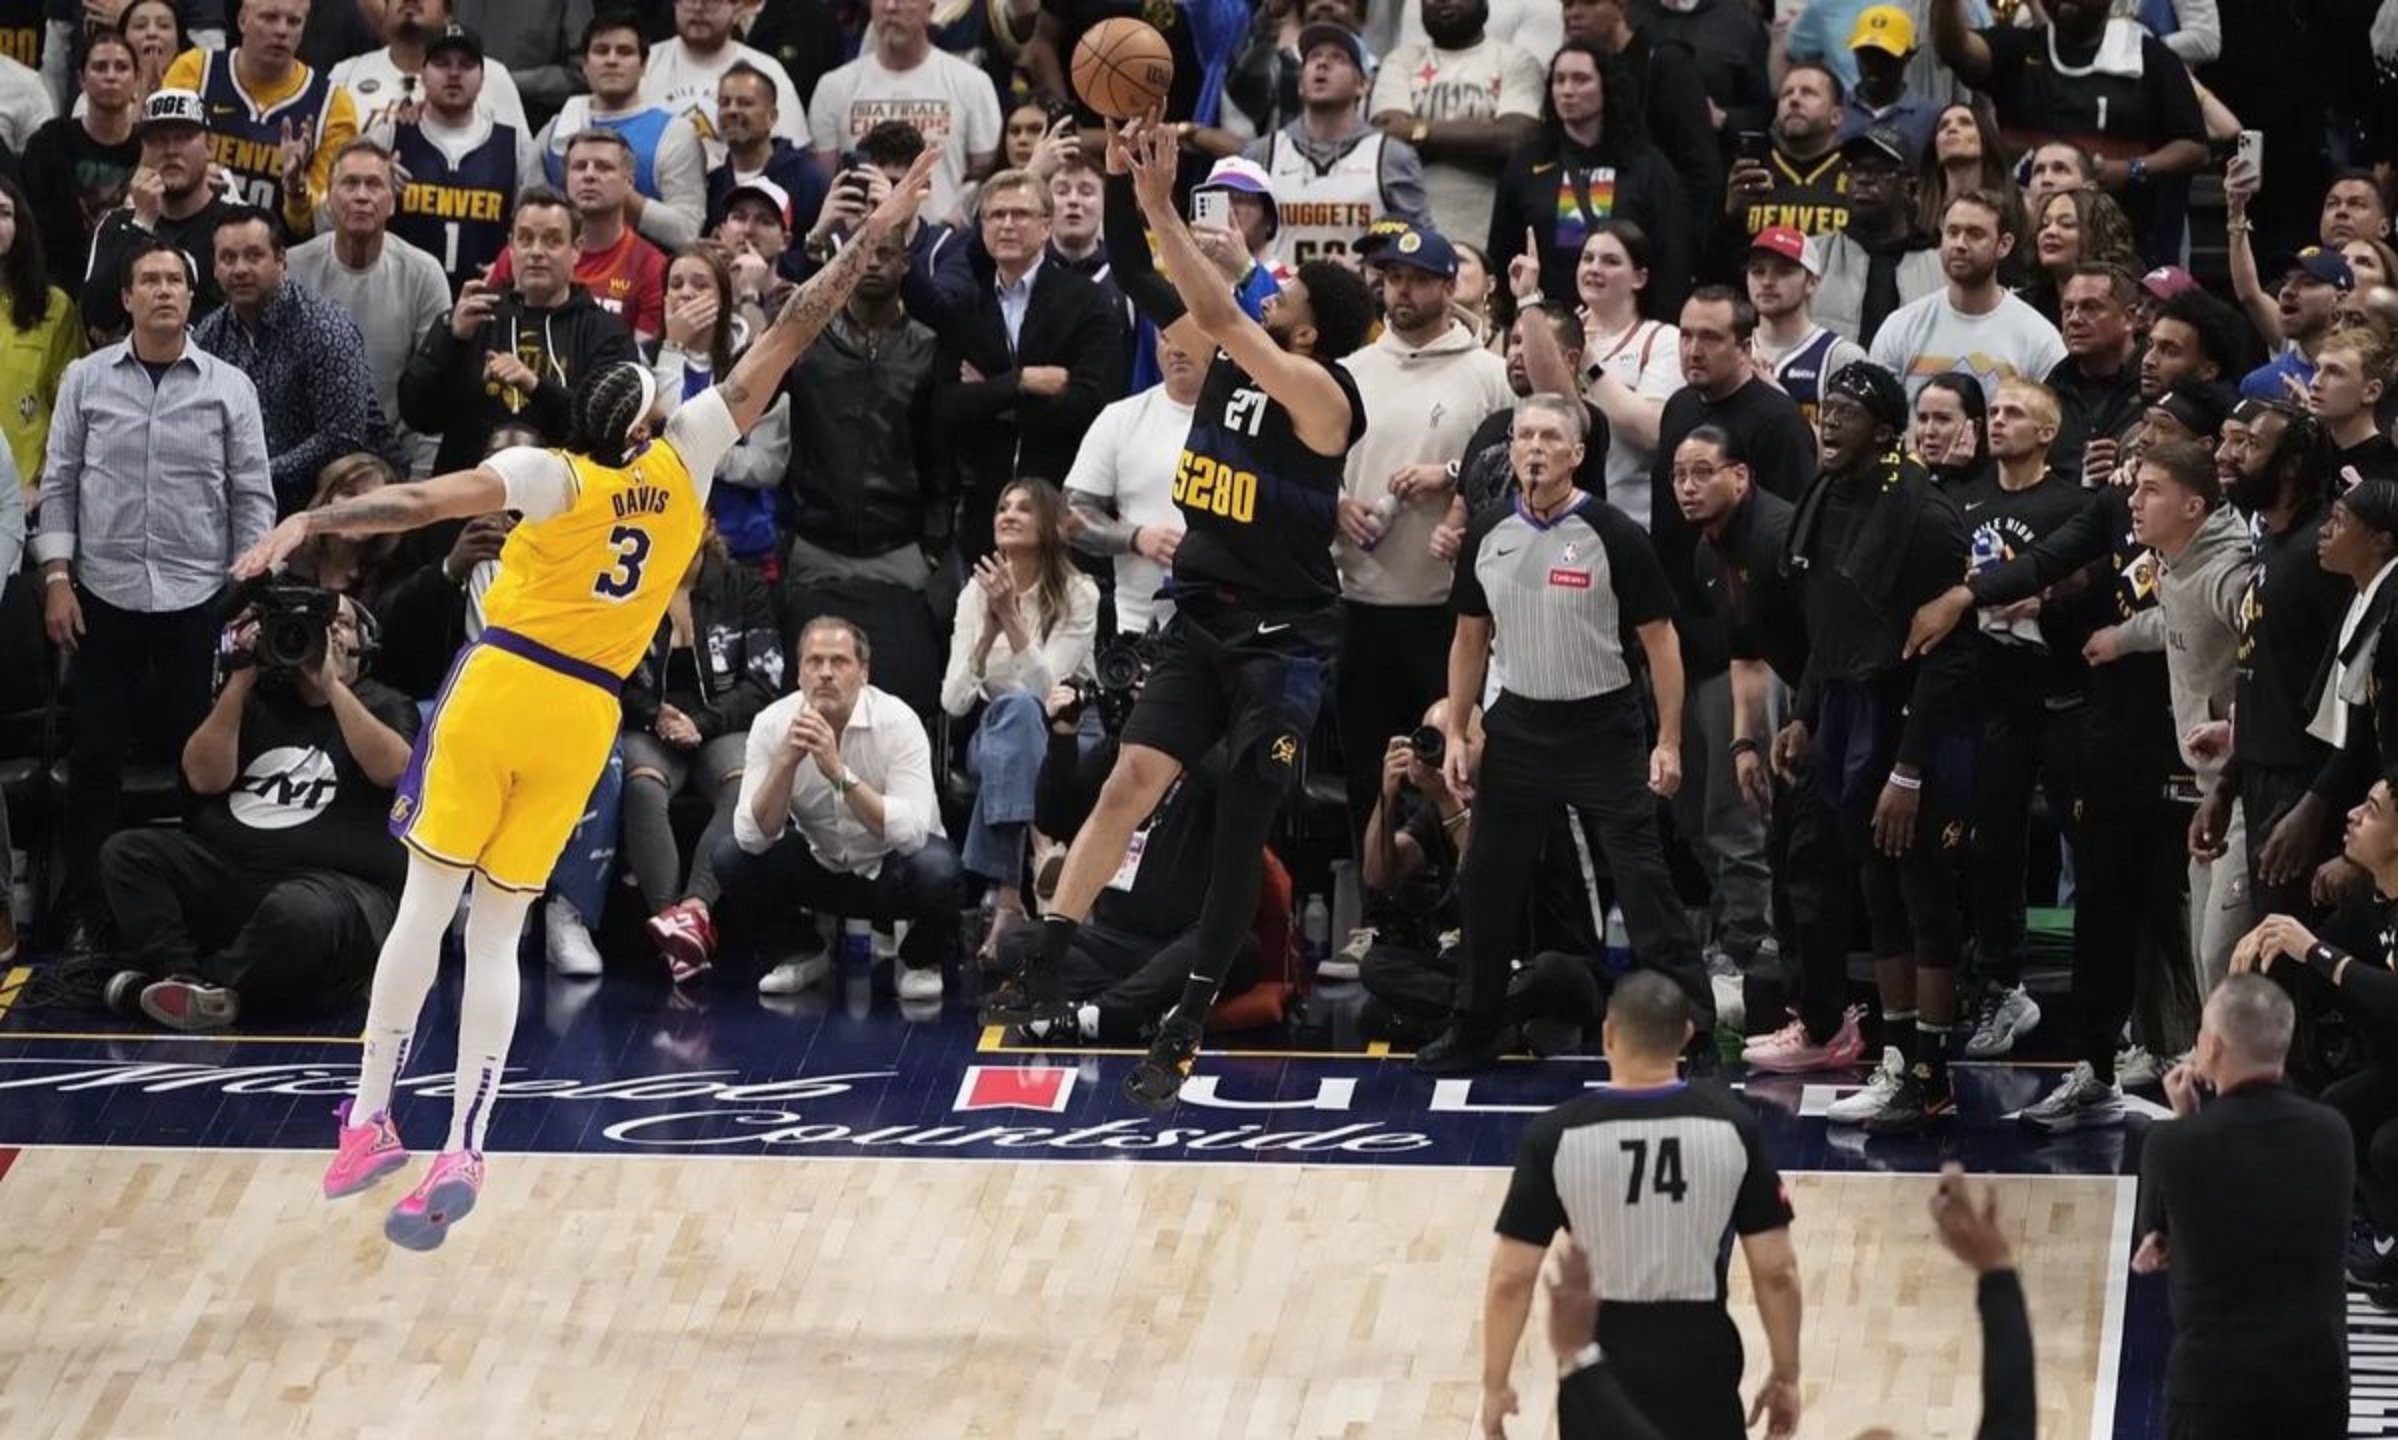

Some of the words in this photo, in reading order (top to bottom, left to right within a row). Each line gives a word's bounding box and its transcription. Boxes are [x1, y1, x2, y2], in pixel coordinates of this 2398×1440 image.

[402, 182, 504, 222] DENVER
[1748, 204, 1849, 236] DENVER
[444, 222, 461, 273] 1
[1223, 387, 1269, 437] 27
[611, 485, 670, 517] DAVIS
[1173, 448, 1258, 524] 5280
[593, 523, 652, 600] 3
[603, 1109, 1433, 1151] Courtside
[1619, 1137, 1688, 1205] 74
